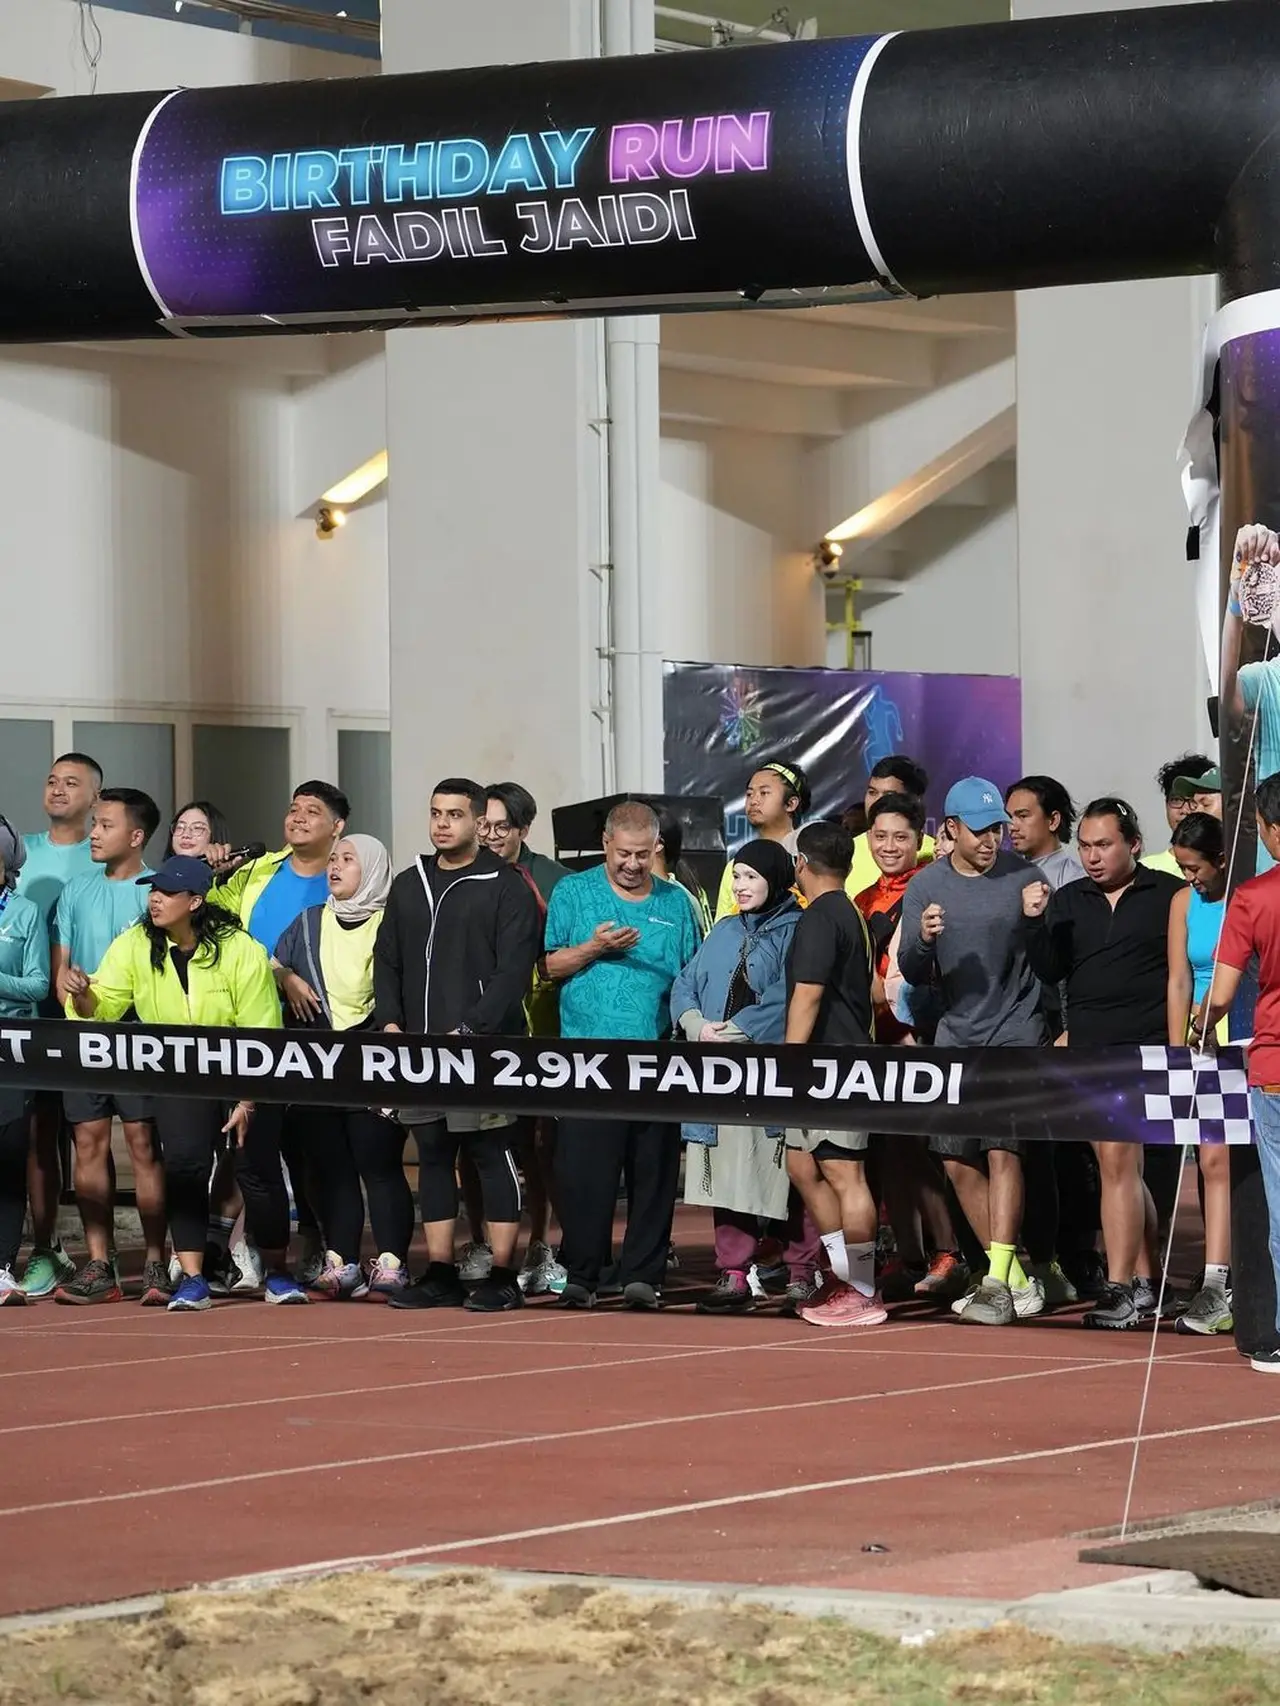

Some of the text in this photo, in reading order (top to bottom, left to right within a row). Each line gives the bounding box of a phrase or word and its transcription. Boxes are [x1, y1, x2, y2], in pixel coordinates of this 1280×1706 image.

[220, 111, 771, 215] BIRTHDAY RUN
[311, 188, 697, 268] FADIL JAIDI
[0, 1029, 31, 1063] T
[78, 1031, 345, 1080] BIRTHDAY
[361, 1044, 476, 1086] RUN
[490, 1049, 612, 1090] 2.9K
[627, 1054, 794, 1097] FADIL
[807, 1058, 963, 1105] JAIDI
